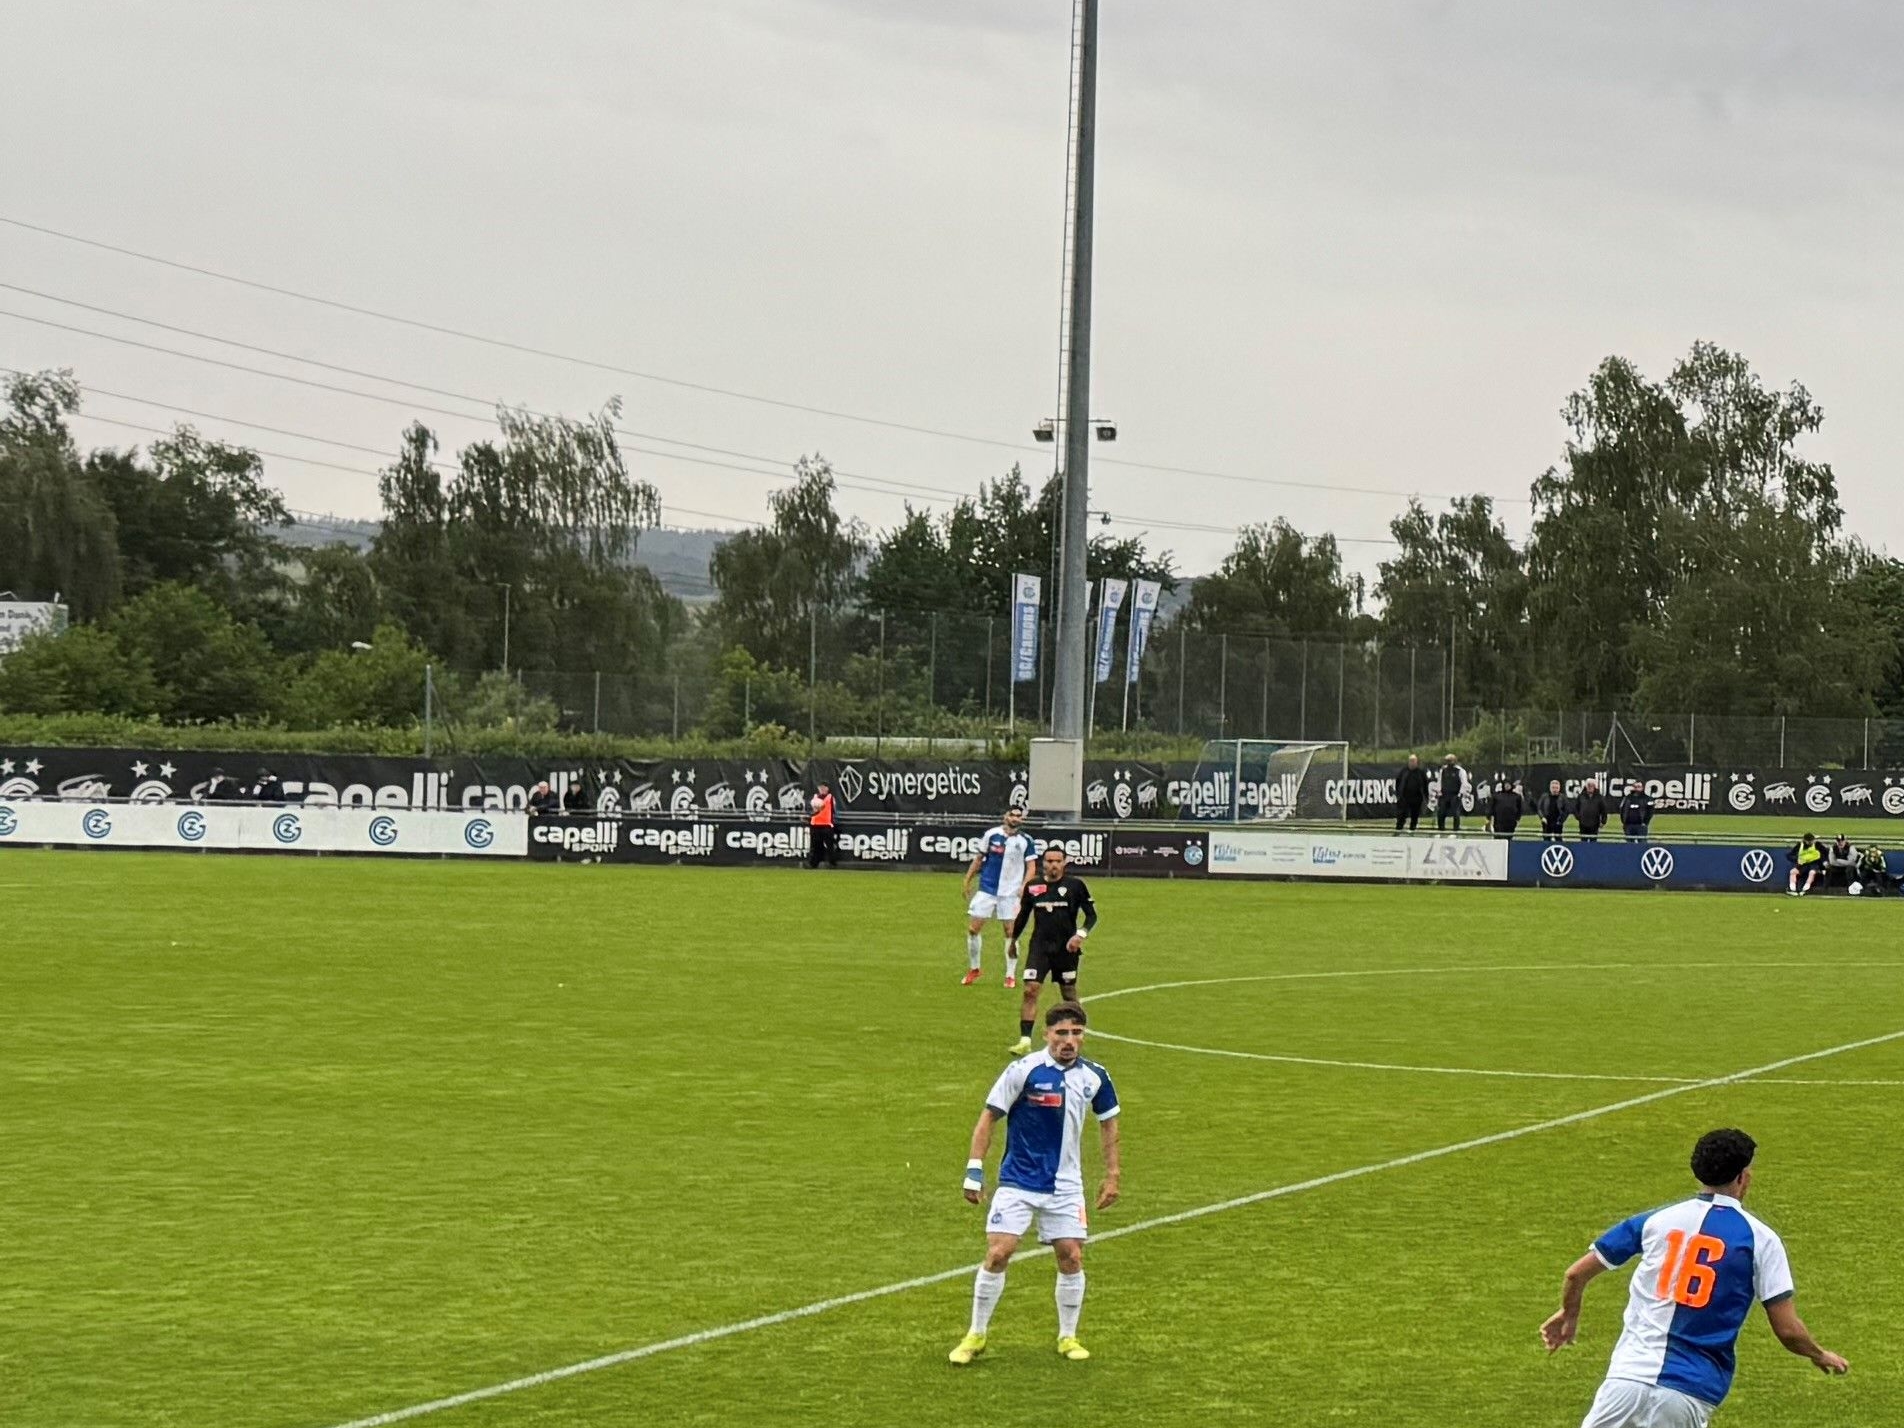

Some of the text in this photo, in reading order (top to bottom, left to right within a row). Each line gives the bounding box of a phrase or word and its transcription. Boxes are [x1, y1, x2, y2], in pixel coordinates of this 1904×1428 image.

[868, 767, 981, 800] synergetics
[1167, 772, 1230, 813] capelli
[1238, 773, 1298, 815] capelli
[1196, 805, 1230, 818] SPORT
[1653, 798, 1709, 810] SPORT
[533, 821, 618, 851] capelli
[571, 842, 617, 853] SPORT
[629, 824, 714, 853] capelli
[668, 845, 713, 856] SPORT
[726, 826, 810, 855] capelli
[834, 828, 908, 858] apelli
[862, 850, 907, 861] SPORT
[1656, 1228, 1726, 1309] 16
